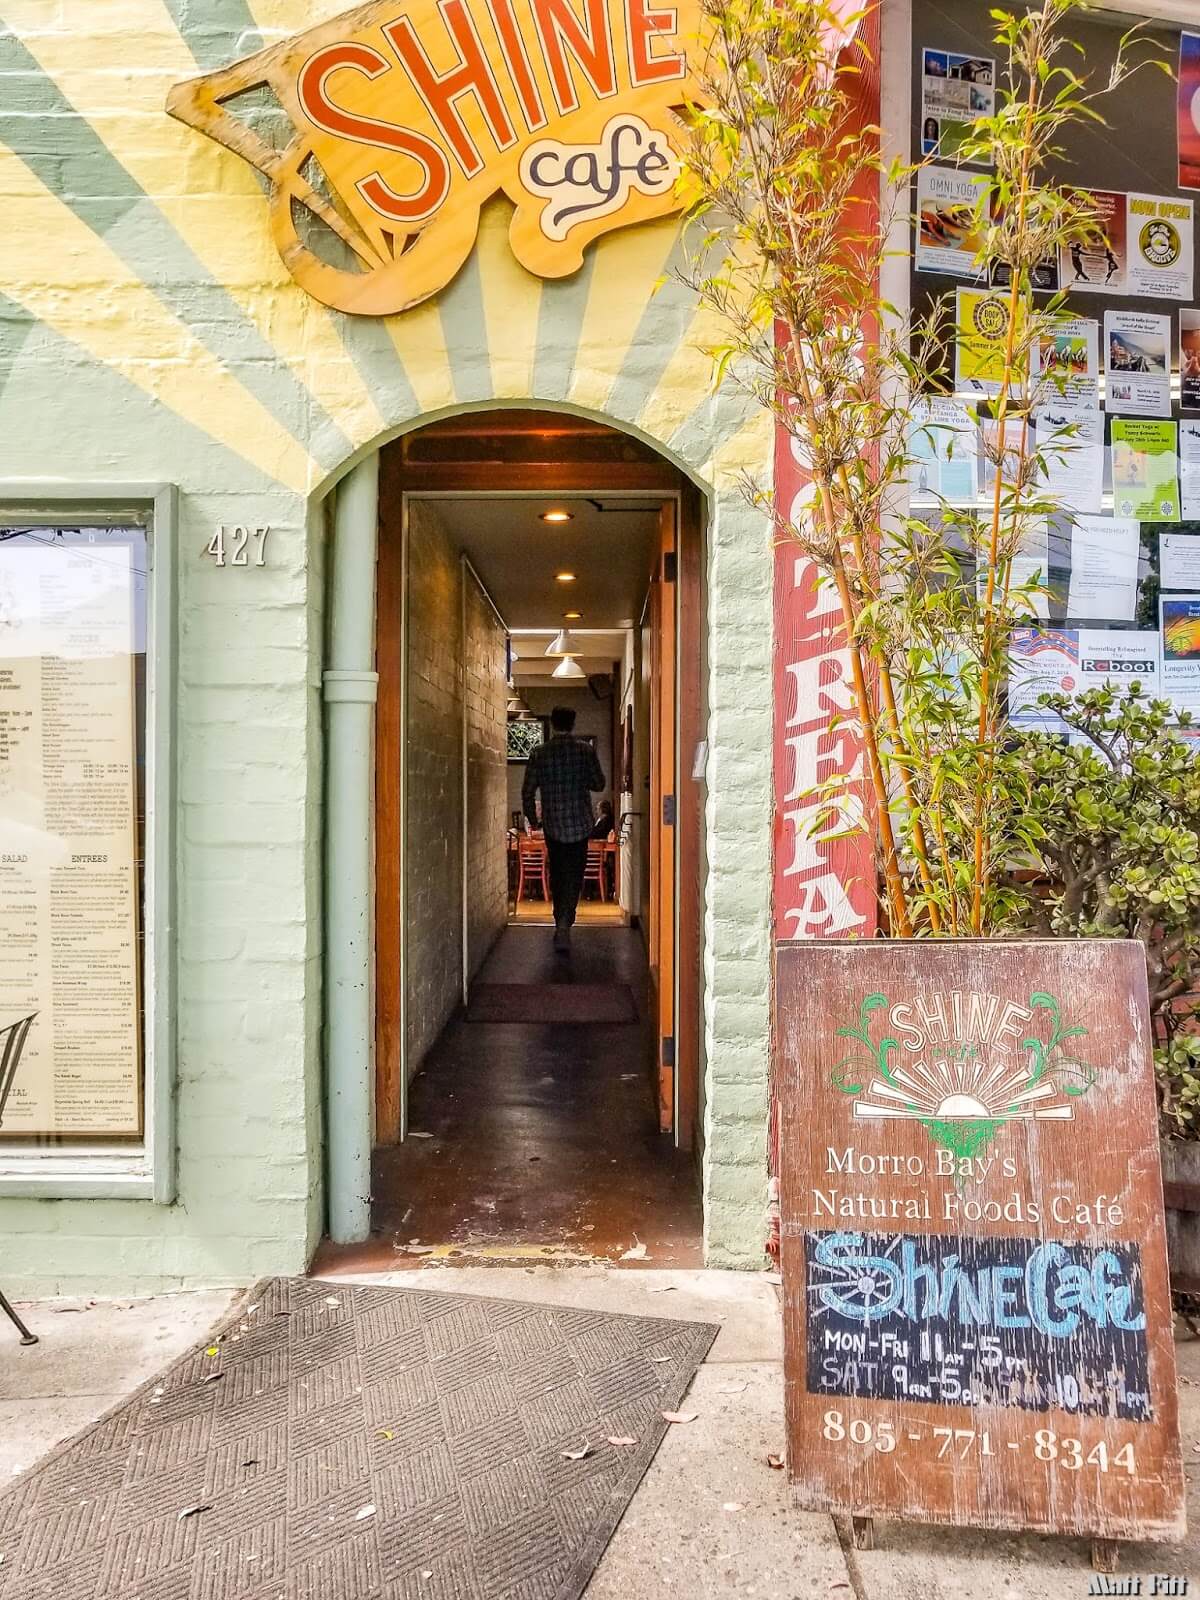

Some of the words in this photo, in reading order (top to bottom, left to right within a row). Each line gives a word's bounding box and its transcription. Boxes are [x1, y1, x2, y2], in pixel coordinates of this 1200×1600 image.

[298, 0, 686, 223] SHINE
[930, 177, 953, 192] OMNI
[956, 183, 978, 198] YOGA
[208, 521, 271, 567] 427
[1083, 660, 1154, 672] Reboot
[71, 854, 108, 863] ENTREES
[889, 990, 1034, 1054] SHINE
[825, 1147, 924, 1177] Morro
[935, 1148, 1018, 1185] Bay's
[812, 1188, 932, 1221] Natural
[943, 1192, 1041, 1223] Foods
[1052, 1194, 1125, 1226] Café
[818, 1357, 879, 1392] SAT
[822, 1410, 897, 1454] 805
[932, 1426, 997, 1462] 771
[1033, 1428, 1137, 1475] 8344
